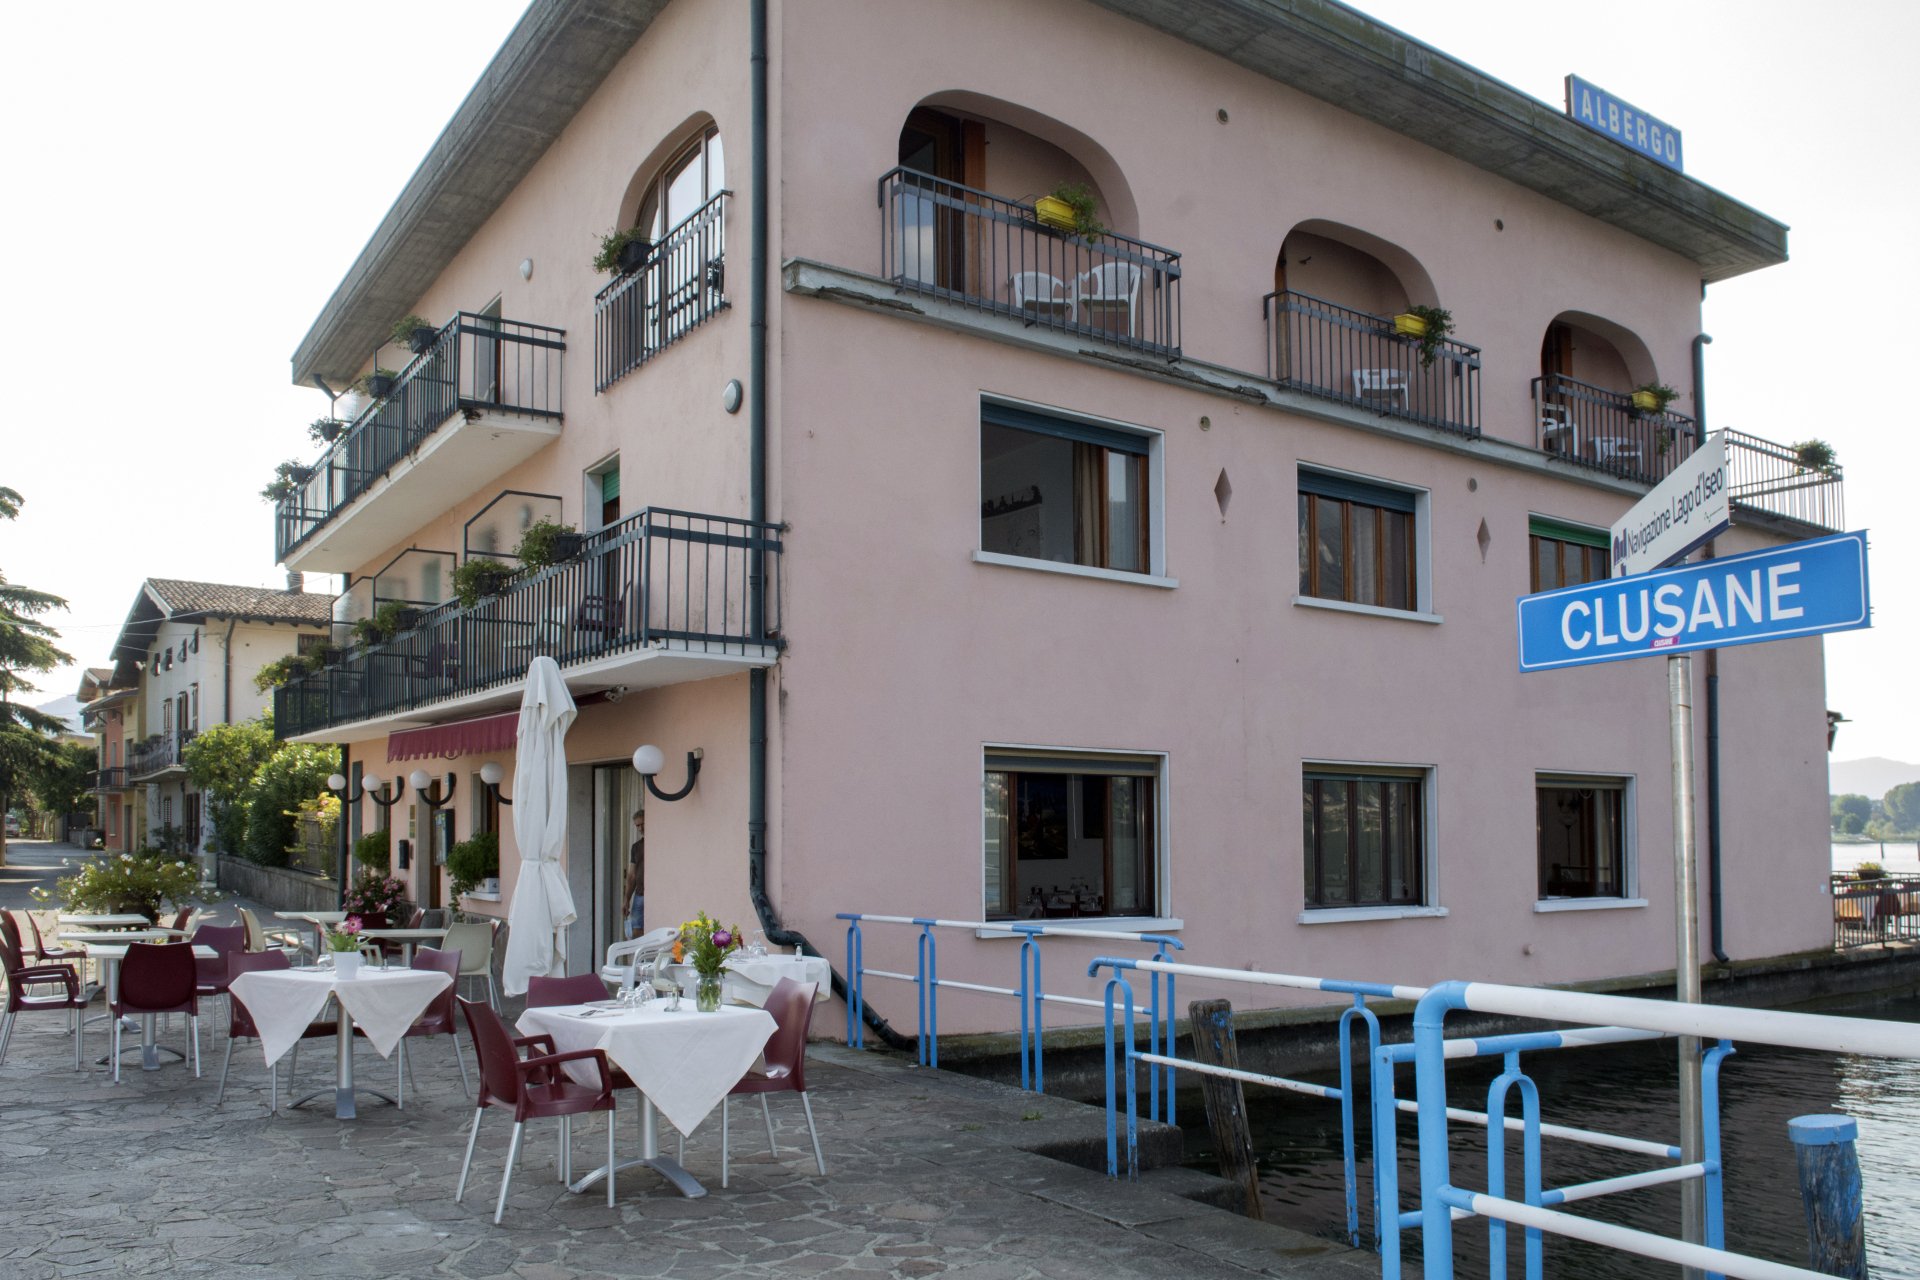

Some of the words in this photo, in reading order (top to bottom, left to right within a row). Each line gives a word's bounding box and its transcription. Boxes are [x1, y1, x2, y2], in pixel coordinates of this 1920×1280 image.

[1582, 88, 1676, 162] ALBERGO
[1627, 508, 1671, 558] Navigazione
[1672, 490, 1694, 524] Lago
[1695, 467, 1723, 507] d'Iseo
[1561, 562, 1804, 650] CLUSANE
